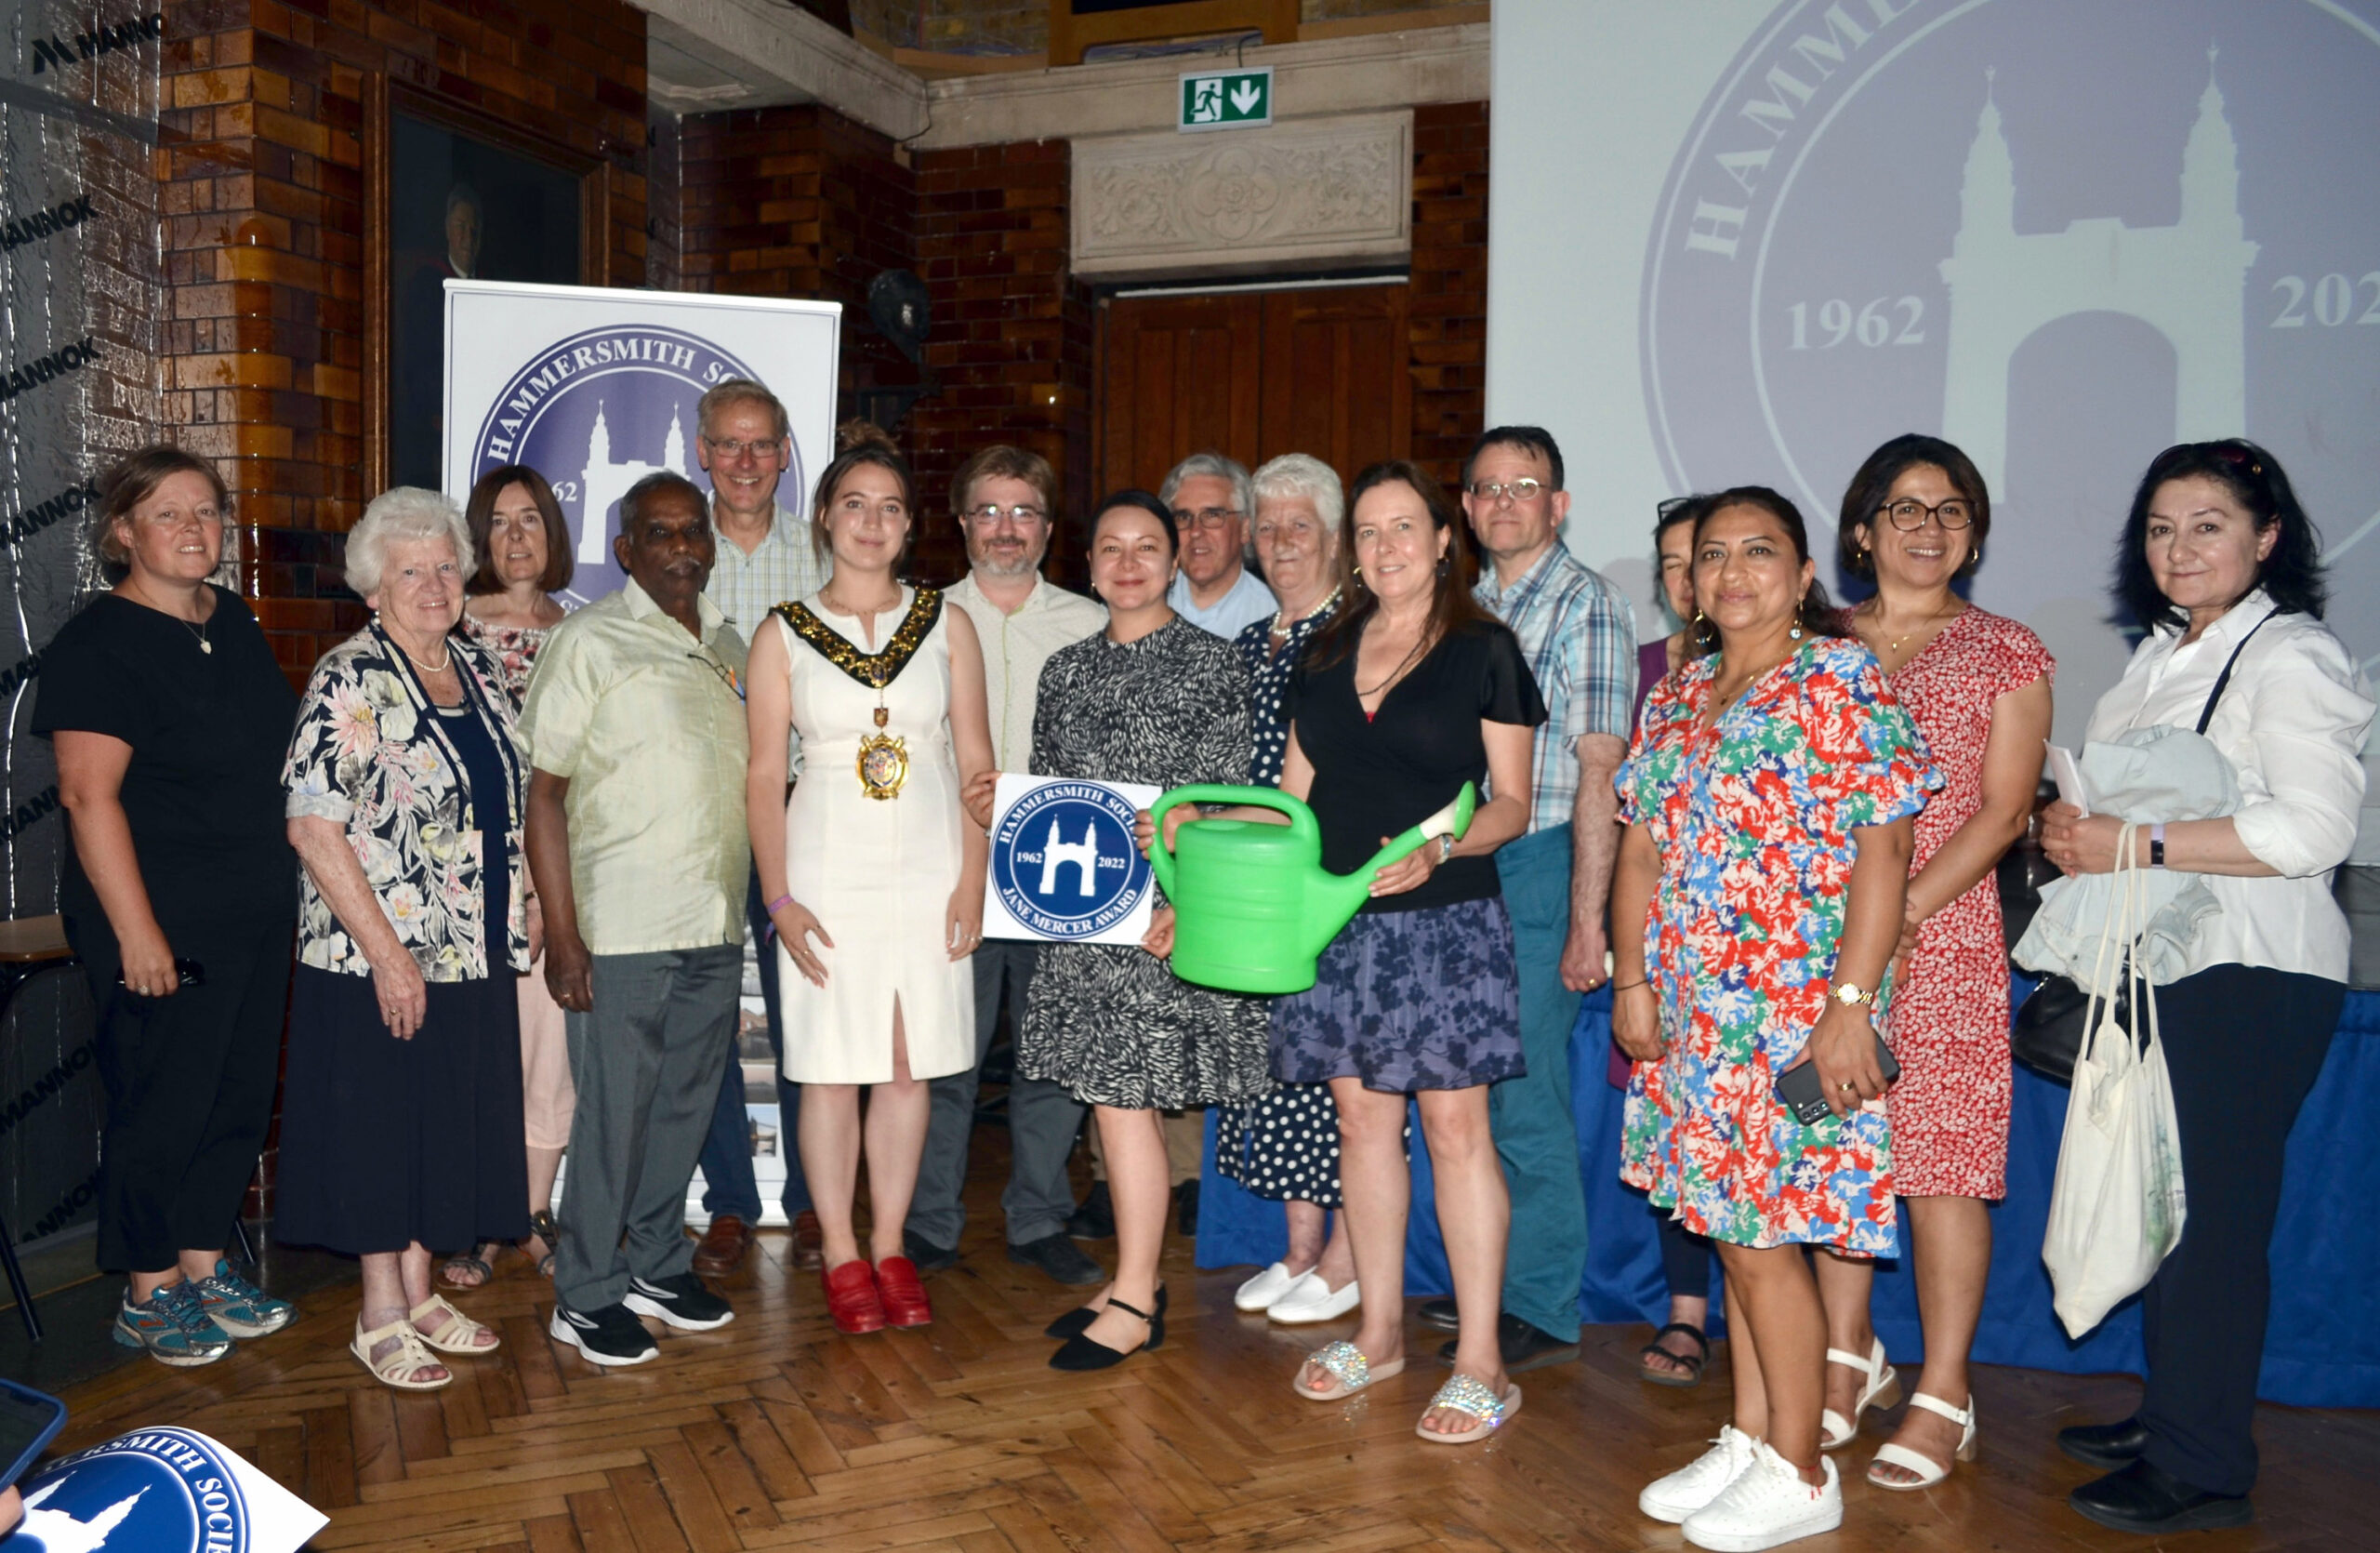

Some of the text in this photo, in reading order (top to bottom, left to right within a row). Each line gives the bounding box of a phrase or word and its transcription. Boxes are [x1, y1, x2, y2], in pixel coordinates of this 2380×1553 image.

[1785, 295, 1925, 351] 1962
[487, 338, 696, 462] HAMMERSMITH
[998, 786, 1104, 844] HAMMERSMITH
[1016, 852, 1043, 864] 1962
[1097, 856, 1126, 869] 2022
[1003, 887, 1137, 935] JANE MERCER AWARD
